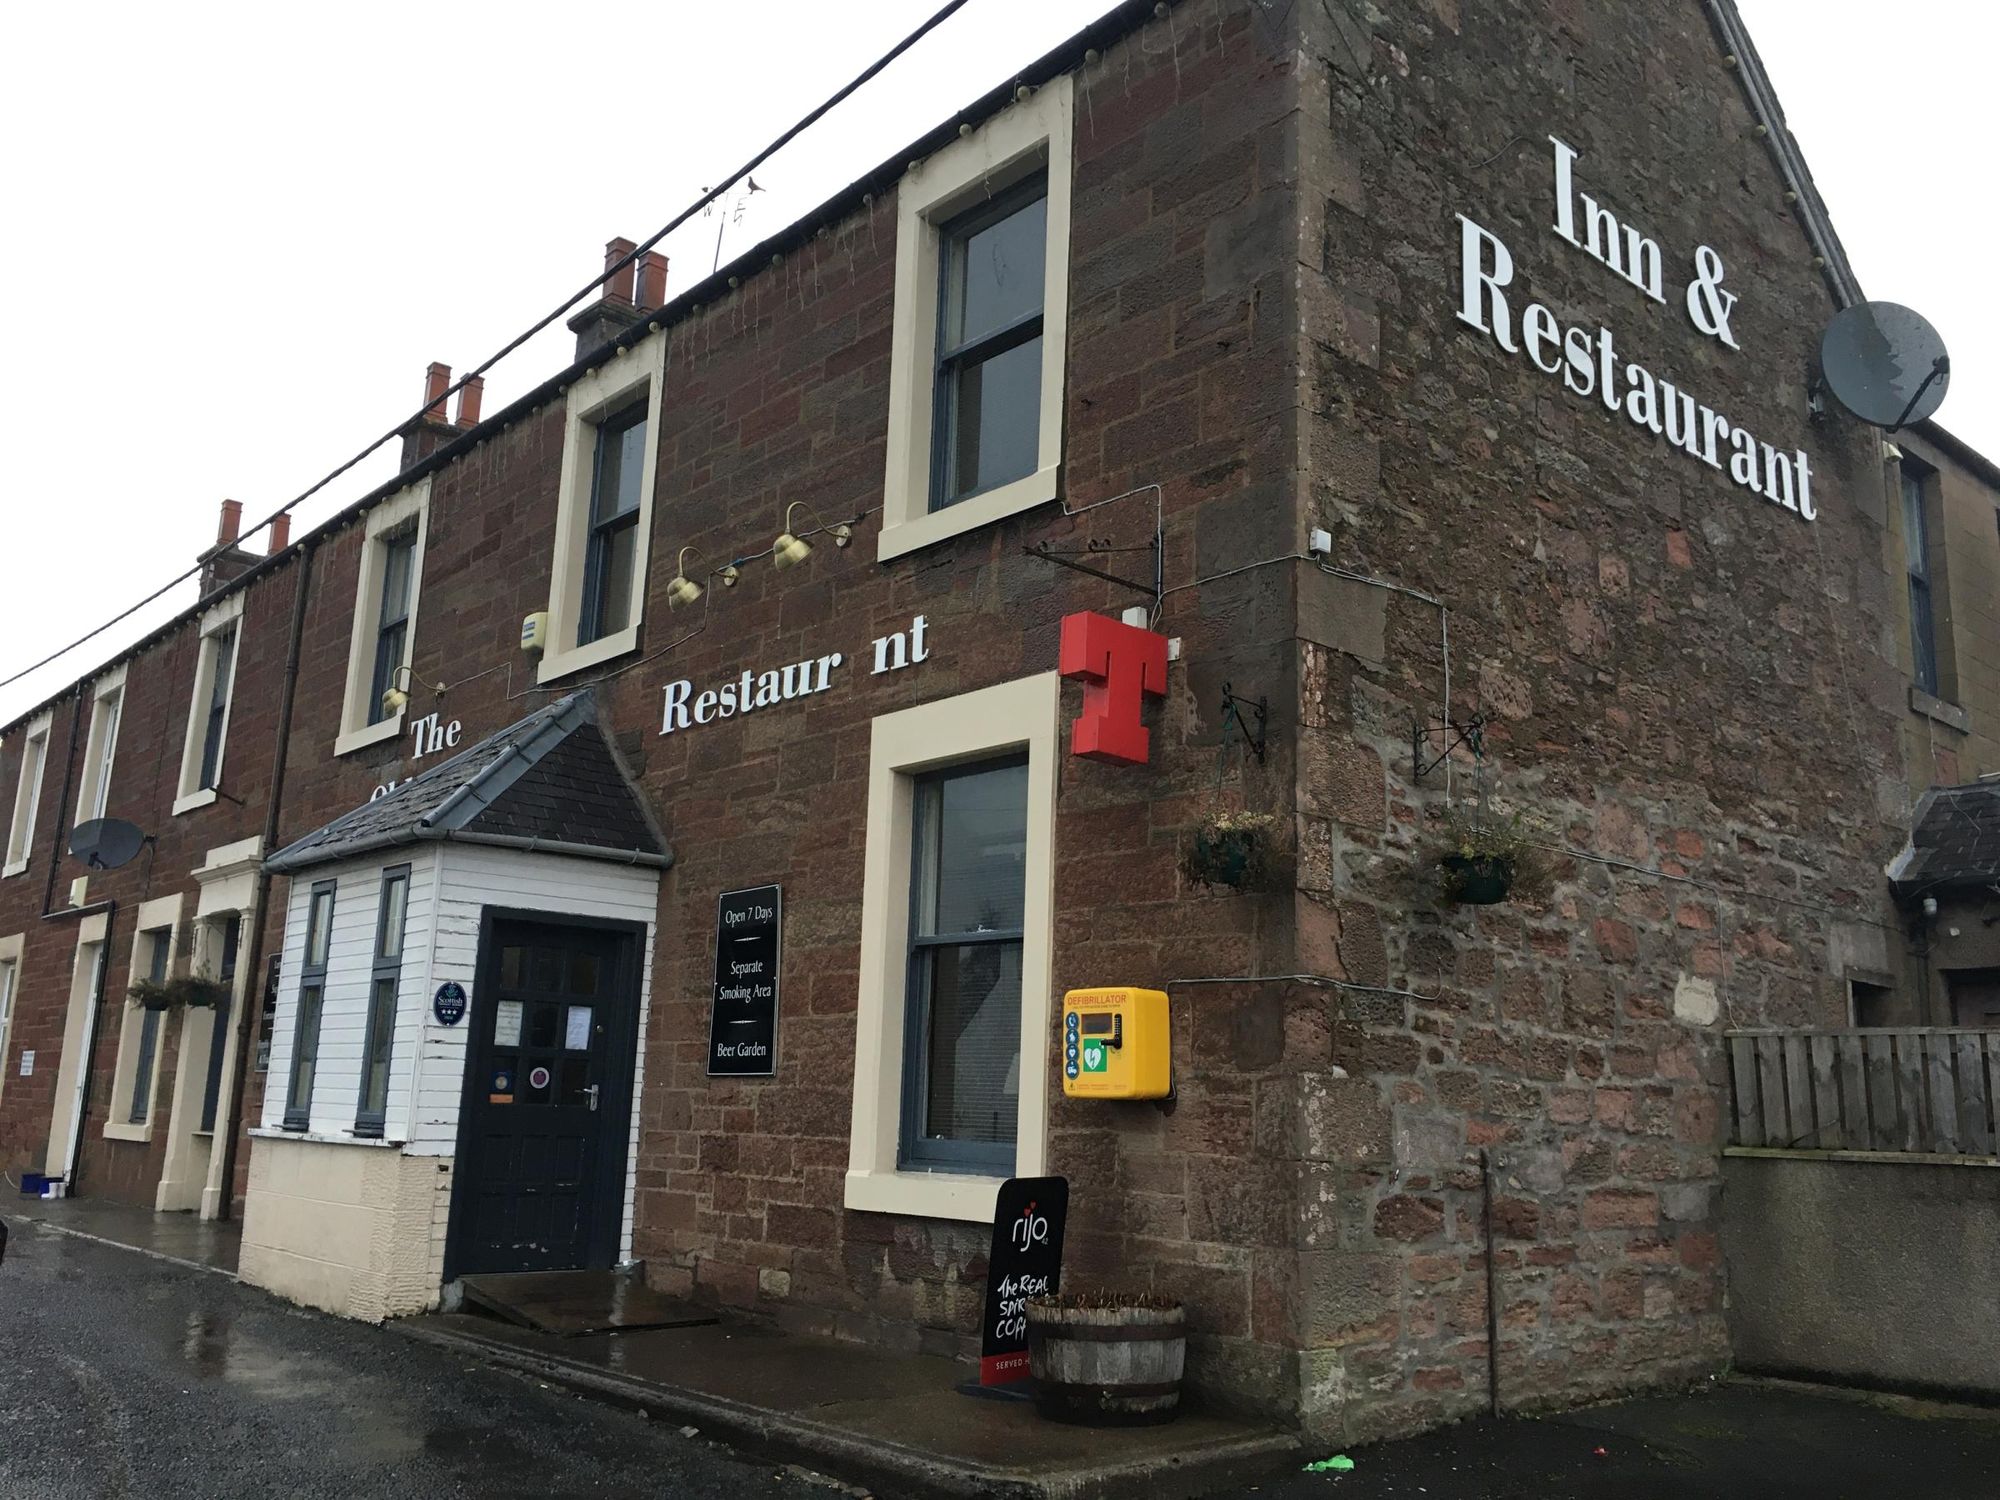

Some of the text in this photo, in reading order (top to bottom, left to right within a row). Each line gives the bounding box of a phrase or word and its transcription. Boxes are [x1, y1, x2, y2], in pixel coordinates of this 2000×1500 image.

[1549, 134, 1741, 351] Inn &
[1456, 212, 1818, 521] Restaurant
[410, 712, 462, 760] The
[725, 905, 773, 928] Open 7 Days
[730, 960, 764, 979] Separate
[438, 996, 463, 1004] Scottish
[719, 984, 772, 1004] Smoking Area
[1067, 994, 1127, 1006] DEFIBRILLATOR
[717, 1041, 767, 1057] Beer Garden
[997, 1273, 1049, 1299] The REAL
[995, 1358, 1024, 1371] SERVED
